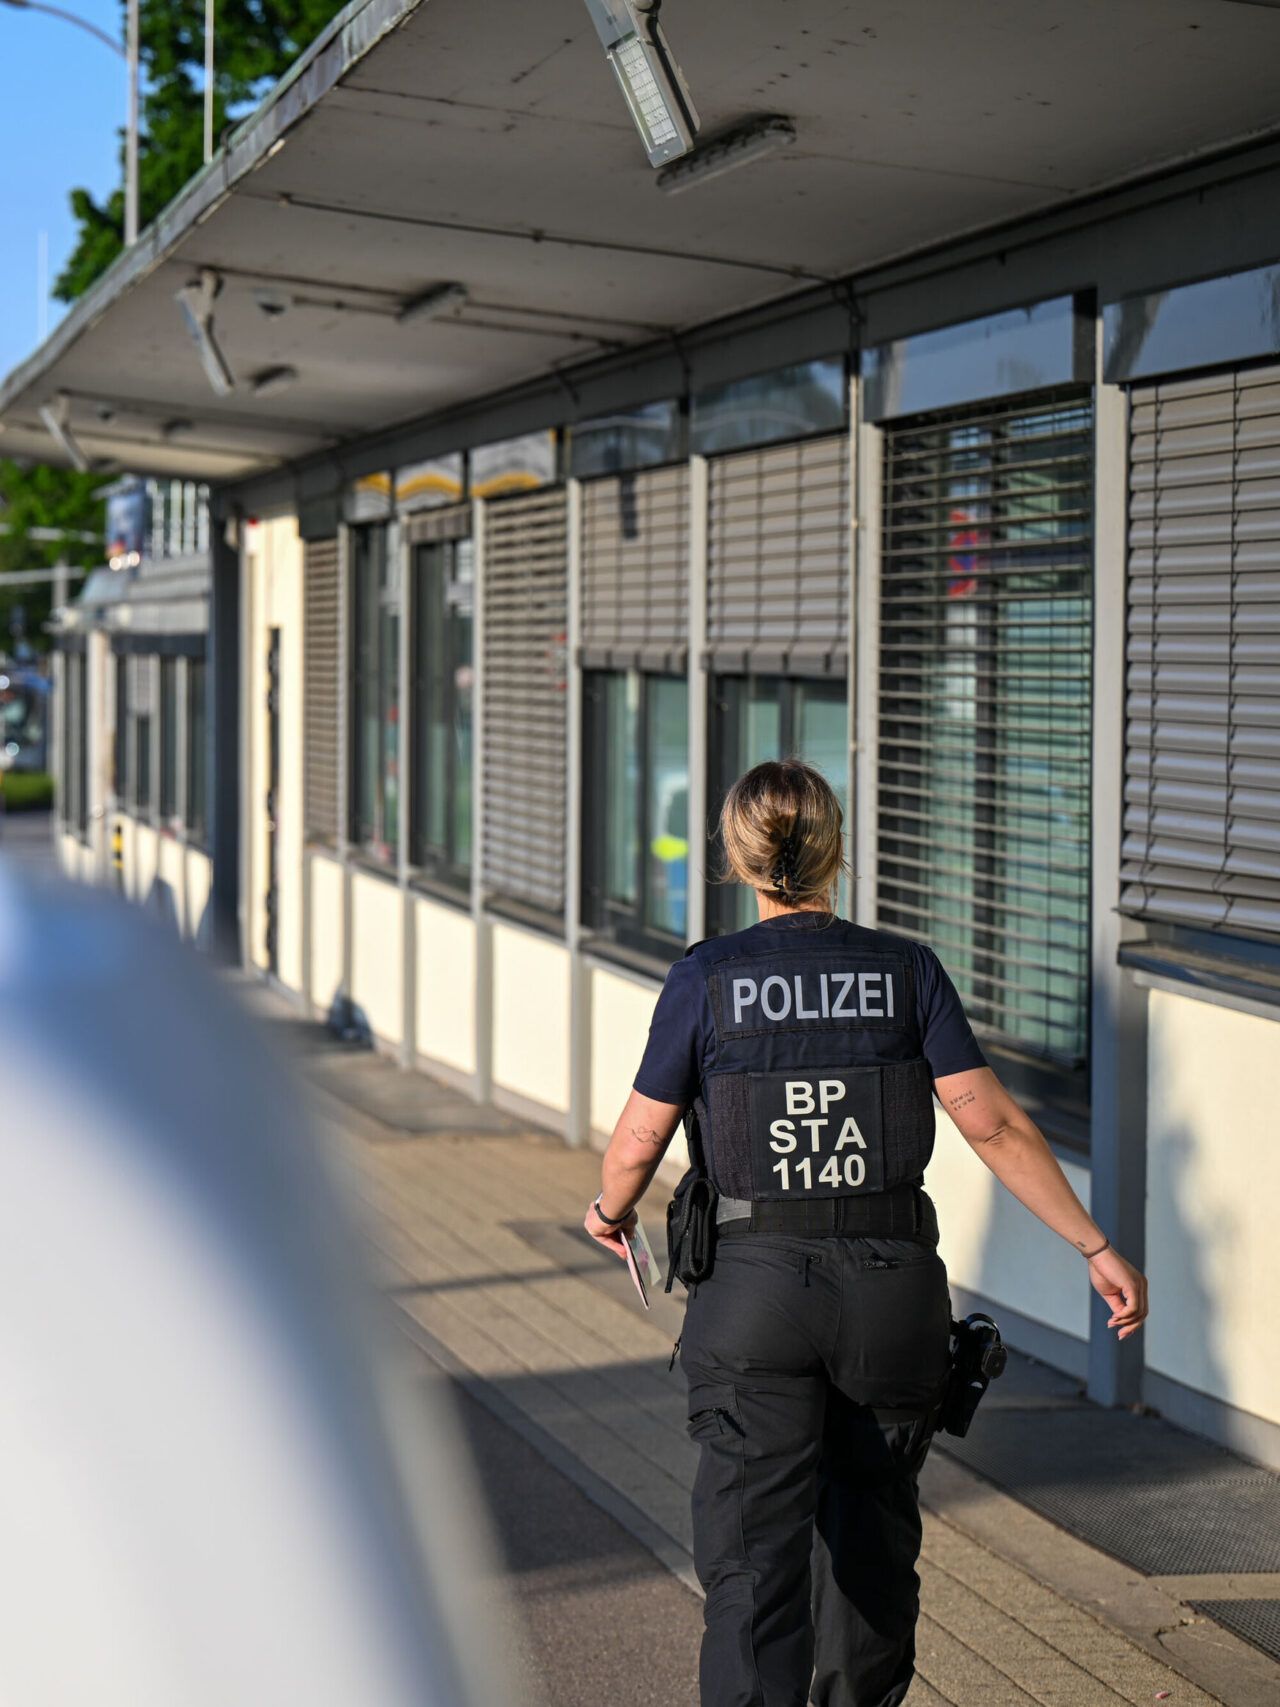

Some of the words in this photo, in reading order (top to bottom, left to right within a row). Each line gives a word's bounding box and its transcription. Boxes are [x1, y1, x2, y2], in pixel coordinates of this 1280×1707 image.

[732, 972, 894, 1024] POLIZEI
[785, 1079, 846, 1116] BP
[769, 1117, 867, 1154] STA
[772, 1154, 866, 1190] 1140
